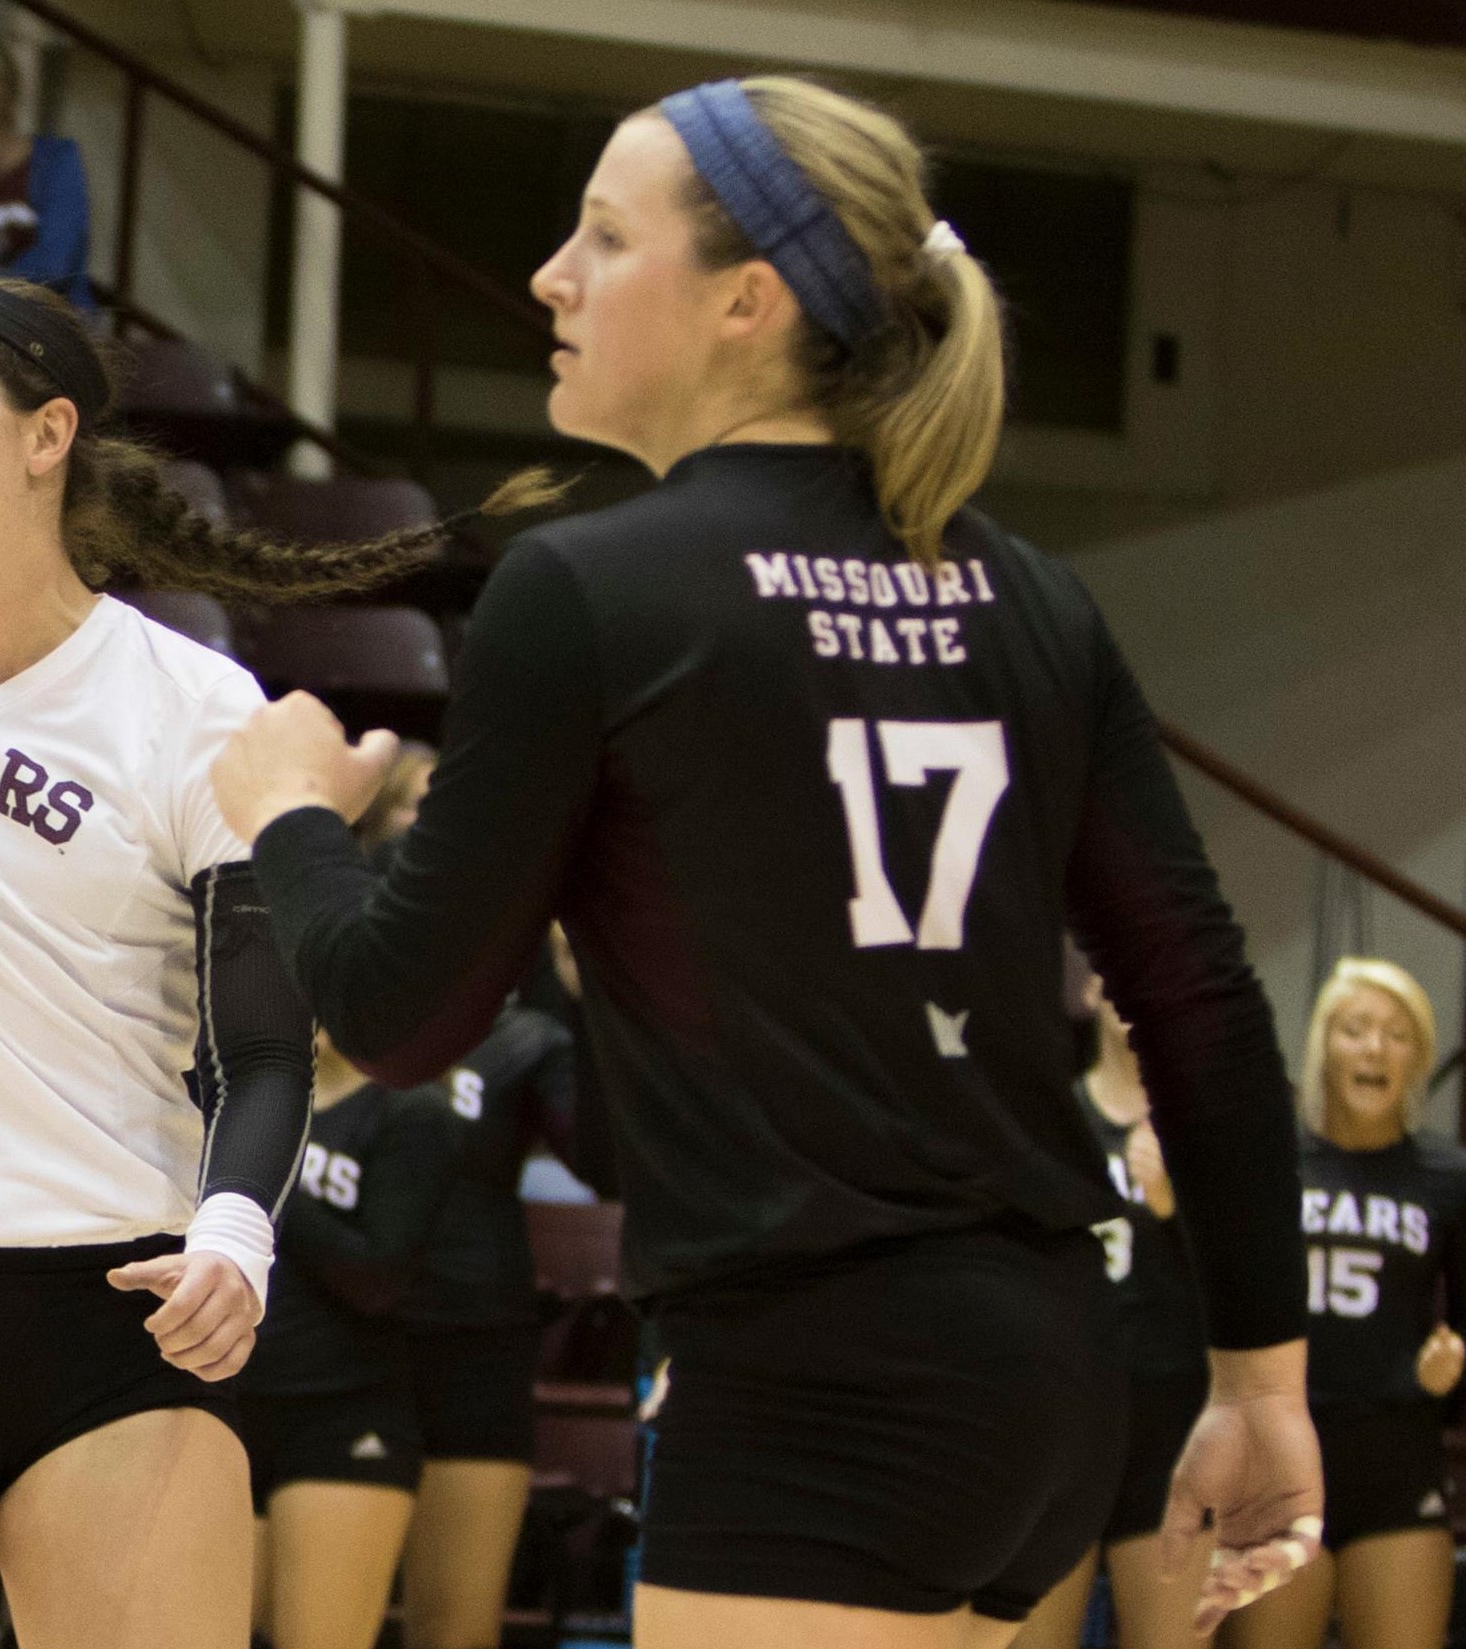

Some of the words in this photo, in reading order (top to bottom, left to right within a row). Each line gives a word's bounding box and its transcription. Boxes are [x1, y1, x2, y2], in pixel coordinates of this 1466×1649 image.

[745, 552, 995, 607] MISSOURI
[807, 610, 967, 665] STATE
[827, 718, 1010, 951] 17
[1306, 1246, 1384, 1318] 15
